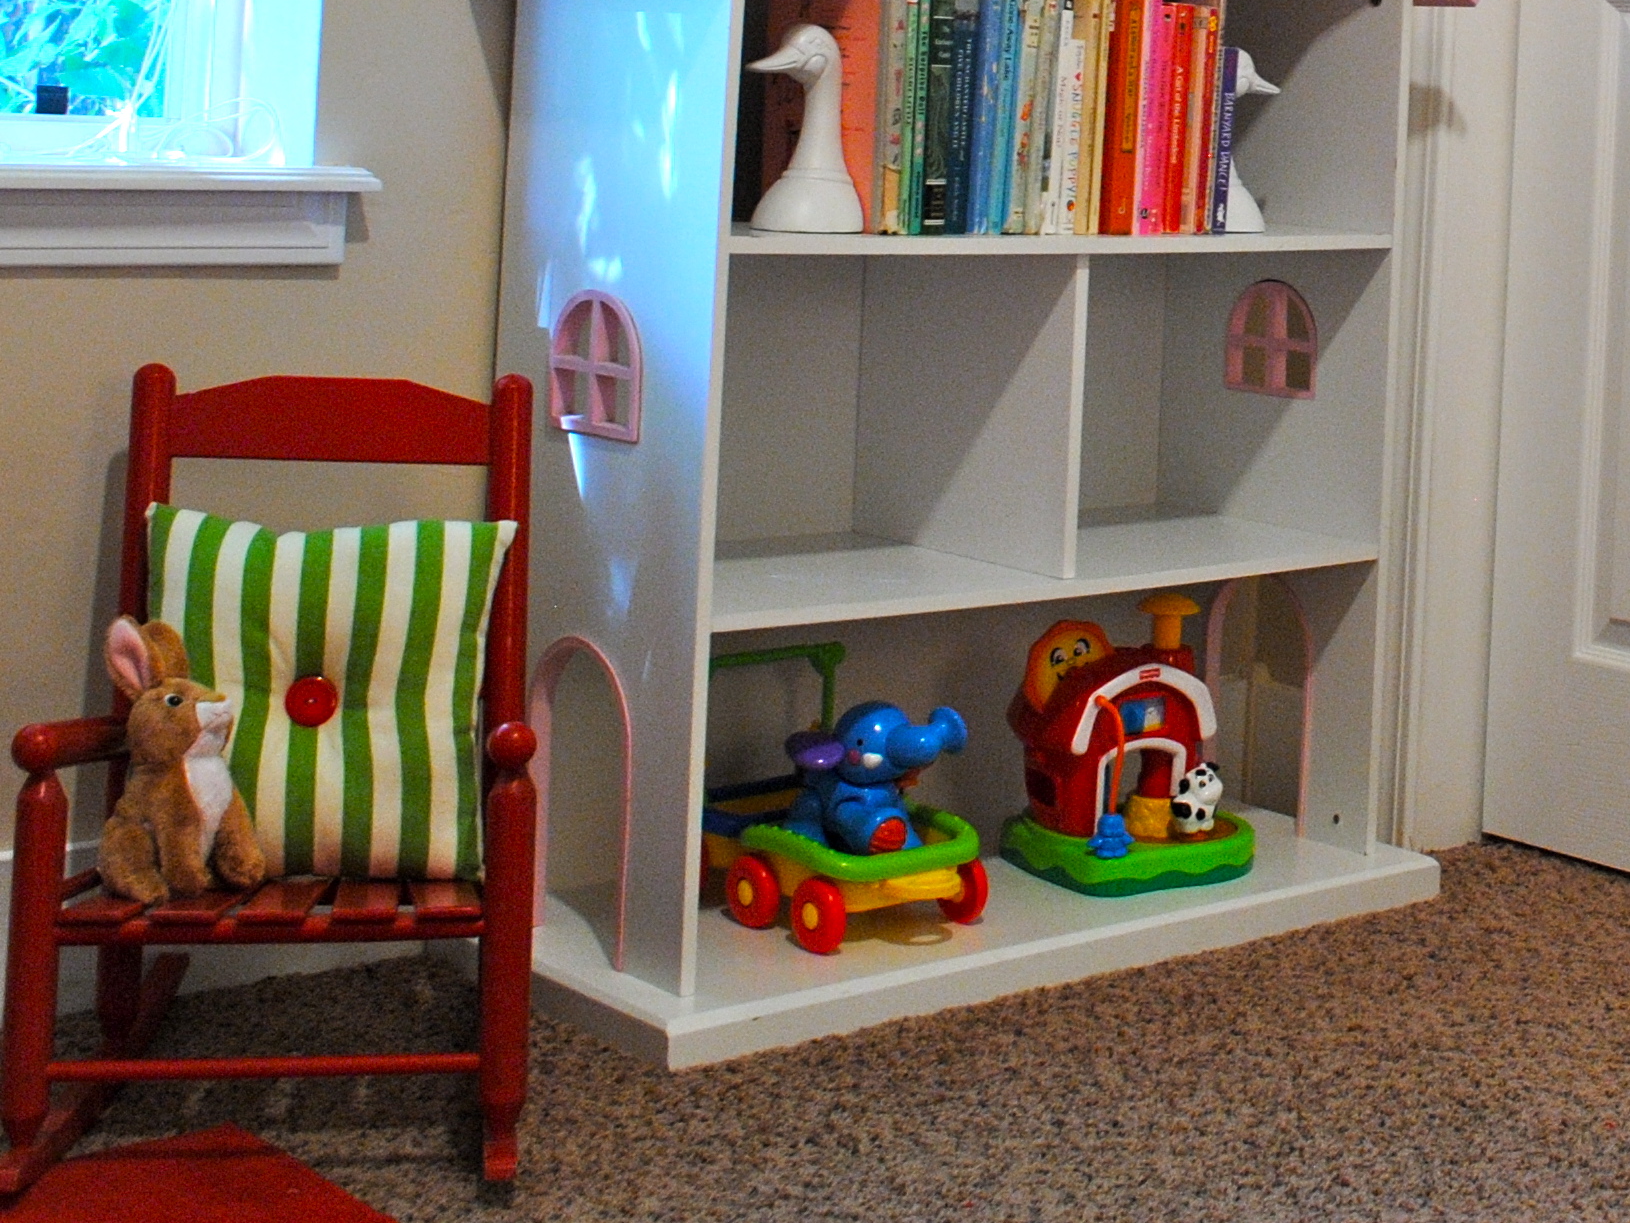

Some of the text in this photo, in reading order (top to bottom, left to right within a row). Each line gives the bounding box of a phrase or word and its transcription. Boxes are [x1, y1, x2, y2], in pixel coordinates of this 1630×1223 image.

[920, 31, 928, 47] The
[1004, 0, 1017, 54] Gone-Away
[956, 49, 964, 68] FIVE
[965, 39, 973, 54] THE
[1004, 57, 1012, 81] Lake
[1176, 65, 1184, 74] A
[954, 71, 963, 117] CHILDREN
[962, 58, 972, 113] ENCHANTED
[1175, 75, 1183, 91] Girl
[1175, 92, 1183, 102] of
[1174, 103, 1182, 117] the
[1220, 92, 1235, 147] BARNYARD
[960, 115, 968, 146] CASTLE
[1067, 84, 1082, 198] SNUGGLE PUPPY!
[1218, 151, 1230, 192] DANCE!
